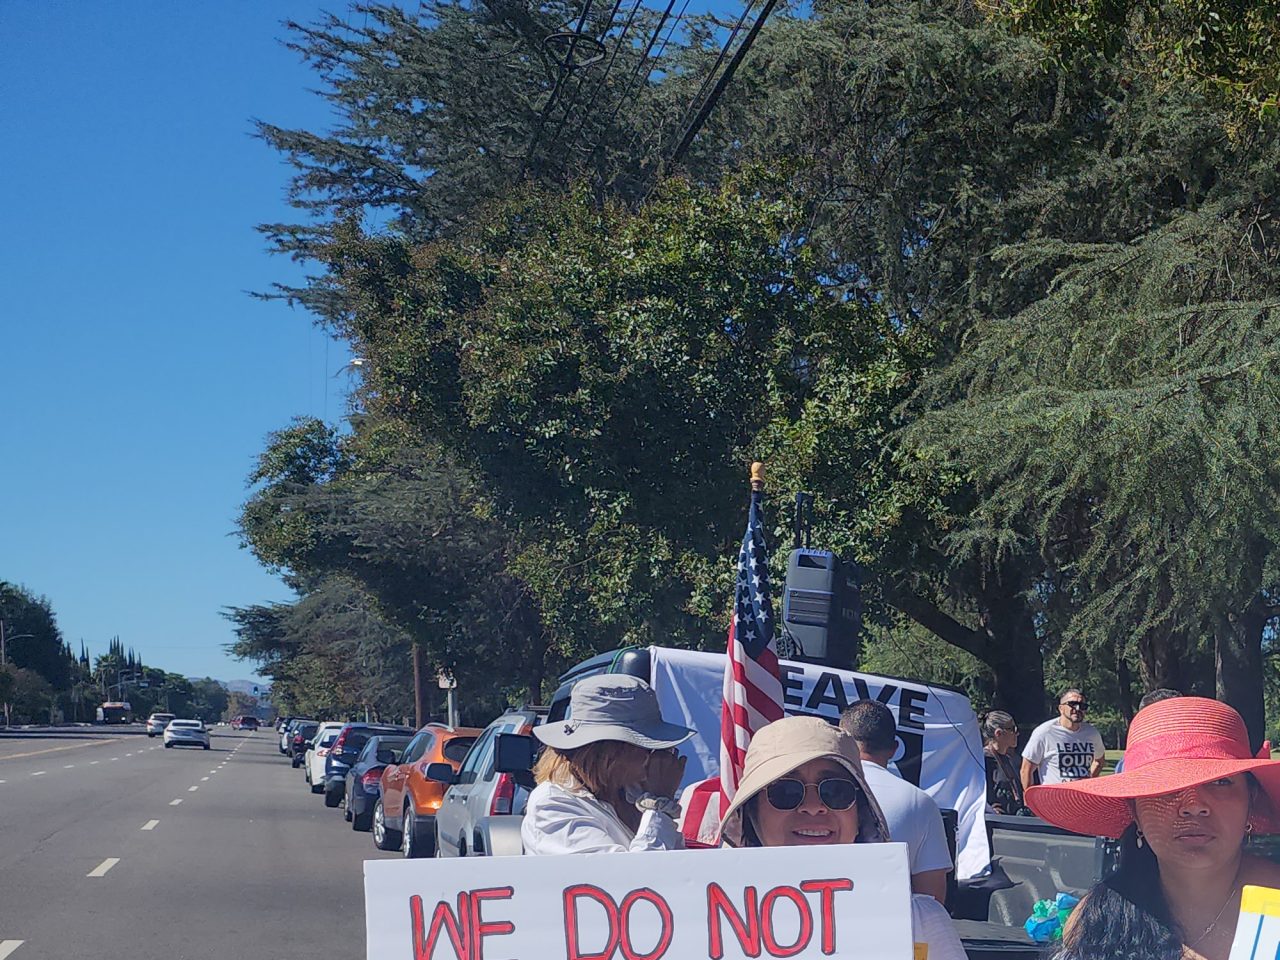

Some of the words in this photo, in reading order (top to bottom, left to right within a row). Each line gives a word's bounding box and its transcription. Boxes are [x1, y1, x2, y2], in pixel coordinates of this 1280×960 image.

[780, 665, 928, 731] EAVE
[1056, 742, 1095, 752] LEAVE
[1061, 754, 1093, 767] OUR
[1060, 766, 1090, 777] KID
[706, 878, 854, 960] NOT
